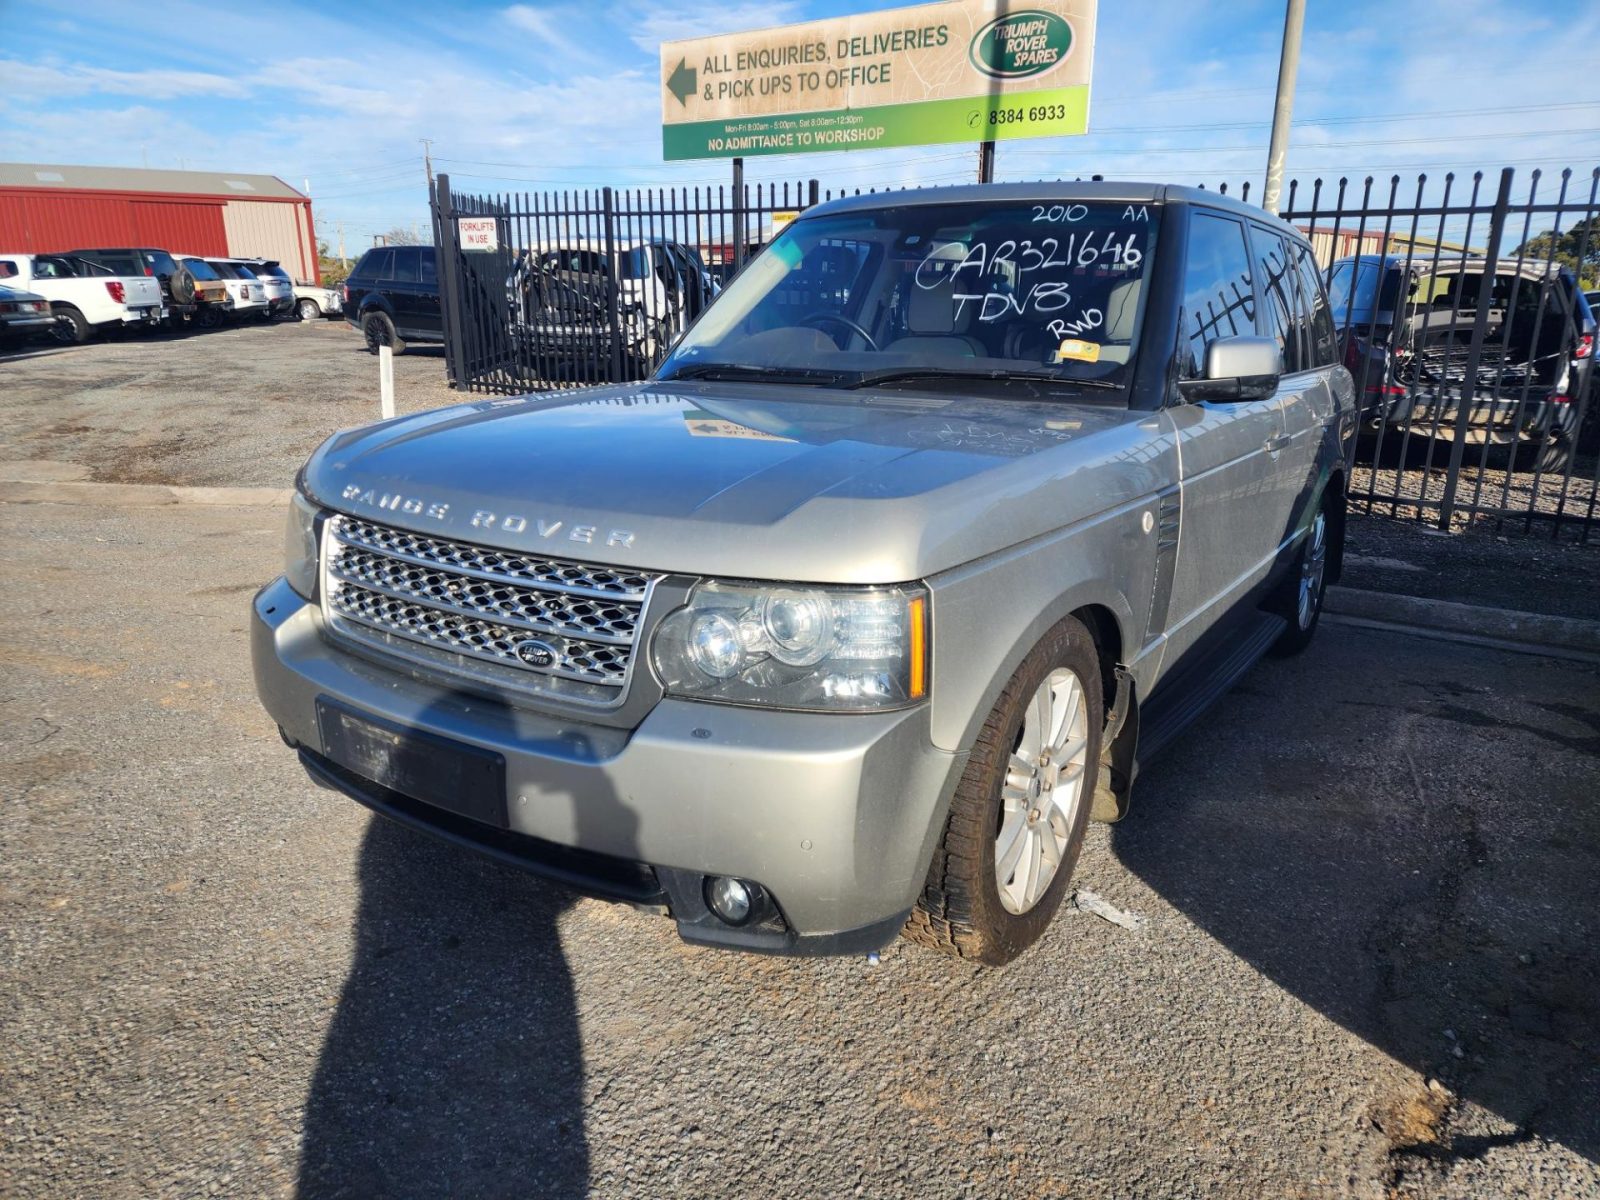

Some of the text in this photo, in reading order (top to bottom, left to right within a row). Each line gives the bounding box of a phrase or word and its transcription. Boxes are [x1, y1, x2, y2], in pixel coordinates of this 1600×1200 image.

[995, 19, 1049, 40] TRIUMPH
[703, 25, 948, 75] ALL ENQUIRIES, DELIVERIES
[1006, 35, 1048, 53] ROVER
[1014, 48, 1058, 67] SPARES
[703, 63, 891, 101] & PICK UPS TO OFFICE
[990, 104, 1065, 125] 8384 6933
[708, 127, 885, 152] NO ADMITTANCE TO WORKSHOP
[1032, 205, 1149, 222] 2010 AA
[460, 223, 494, 231] FORKLIFTS
[467, 235, 488, 243] IN USE
[952, 282, 1071, 322] TDV8
[471, 509, 636, 549] ROVER
[524, 646, 542, 656] LAND
